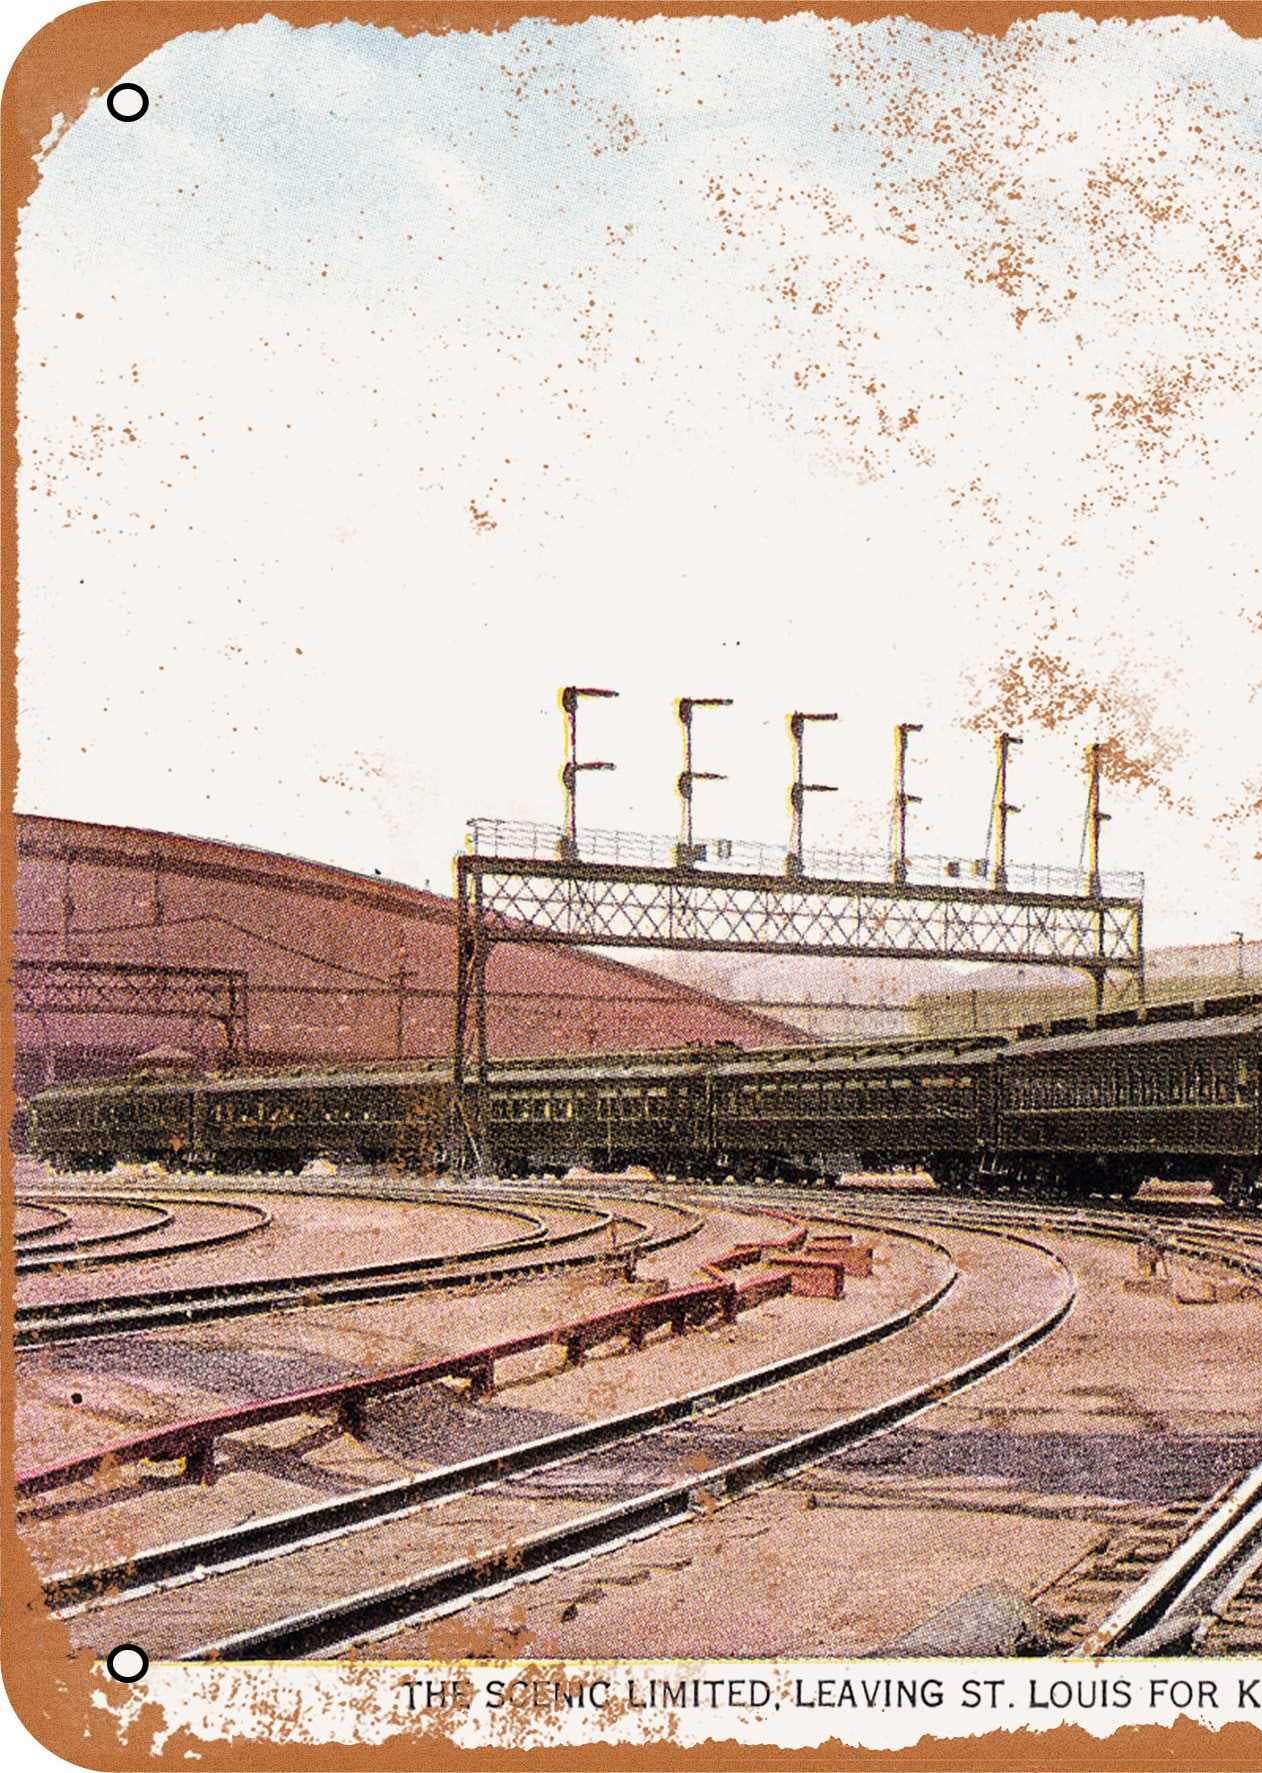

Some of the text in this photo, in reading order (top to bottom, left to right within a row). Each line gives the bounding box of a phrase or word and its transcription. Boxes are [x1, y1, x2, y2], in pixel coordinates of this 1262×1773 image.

[401, 1679, 471, 1711] THE
[485, 1679, 611, 1709] SCENIC
[627, 1679, 780, 1712] LIMITED,
[796, 1679, 943, 1709] LEAVING
[962, 1679, 1014, 1709] ST.
[1030, 1679, 1132, 1709] LOUIS
[1149, 1679, 1218, 1709] FOR
